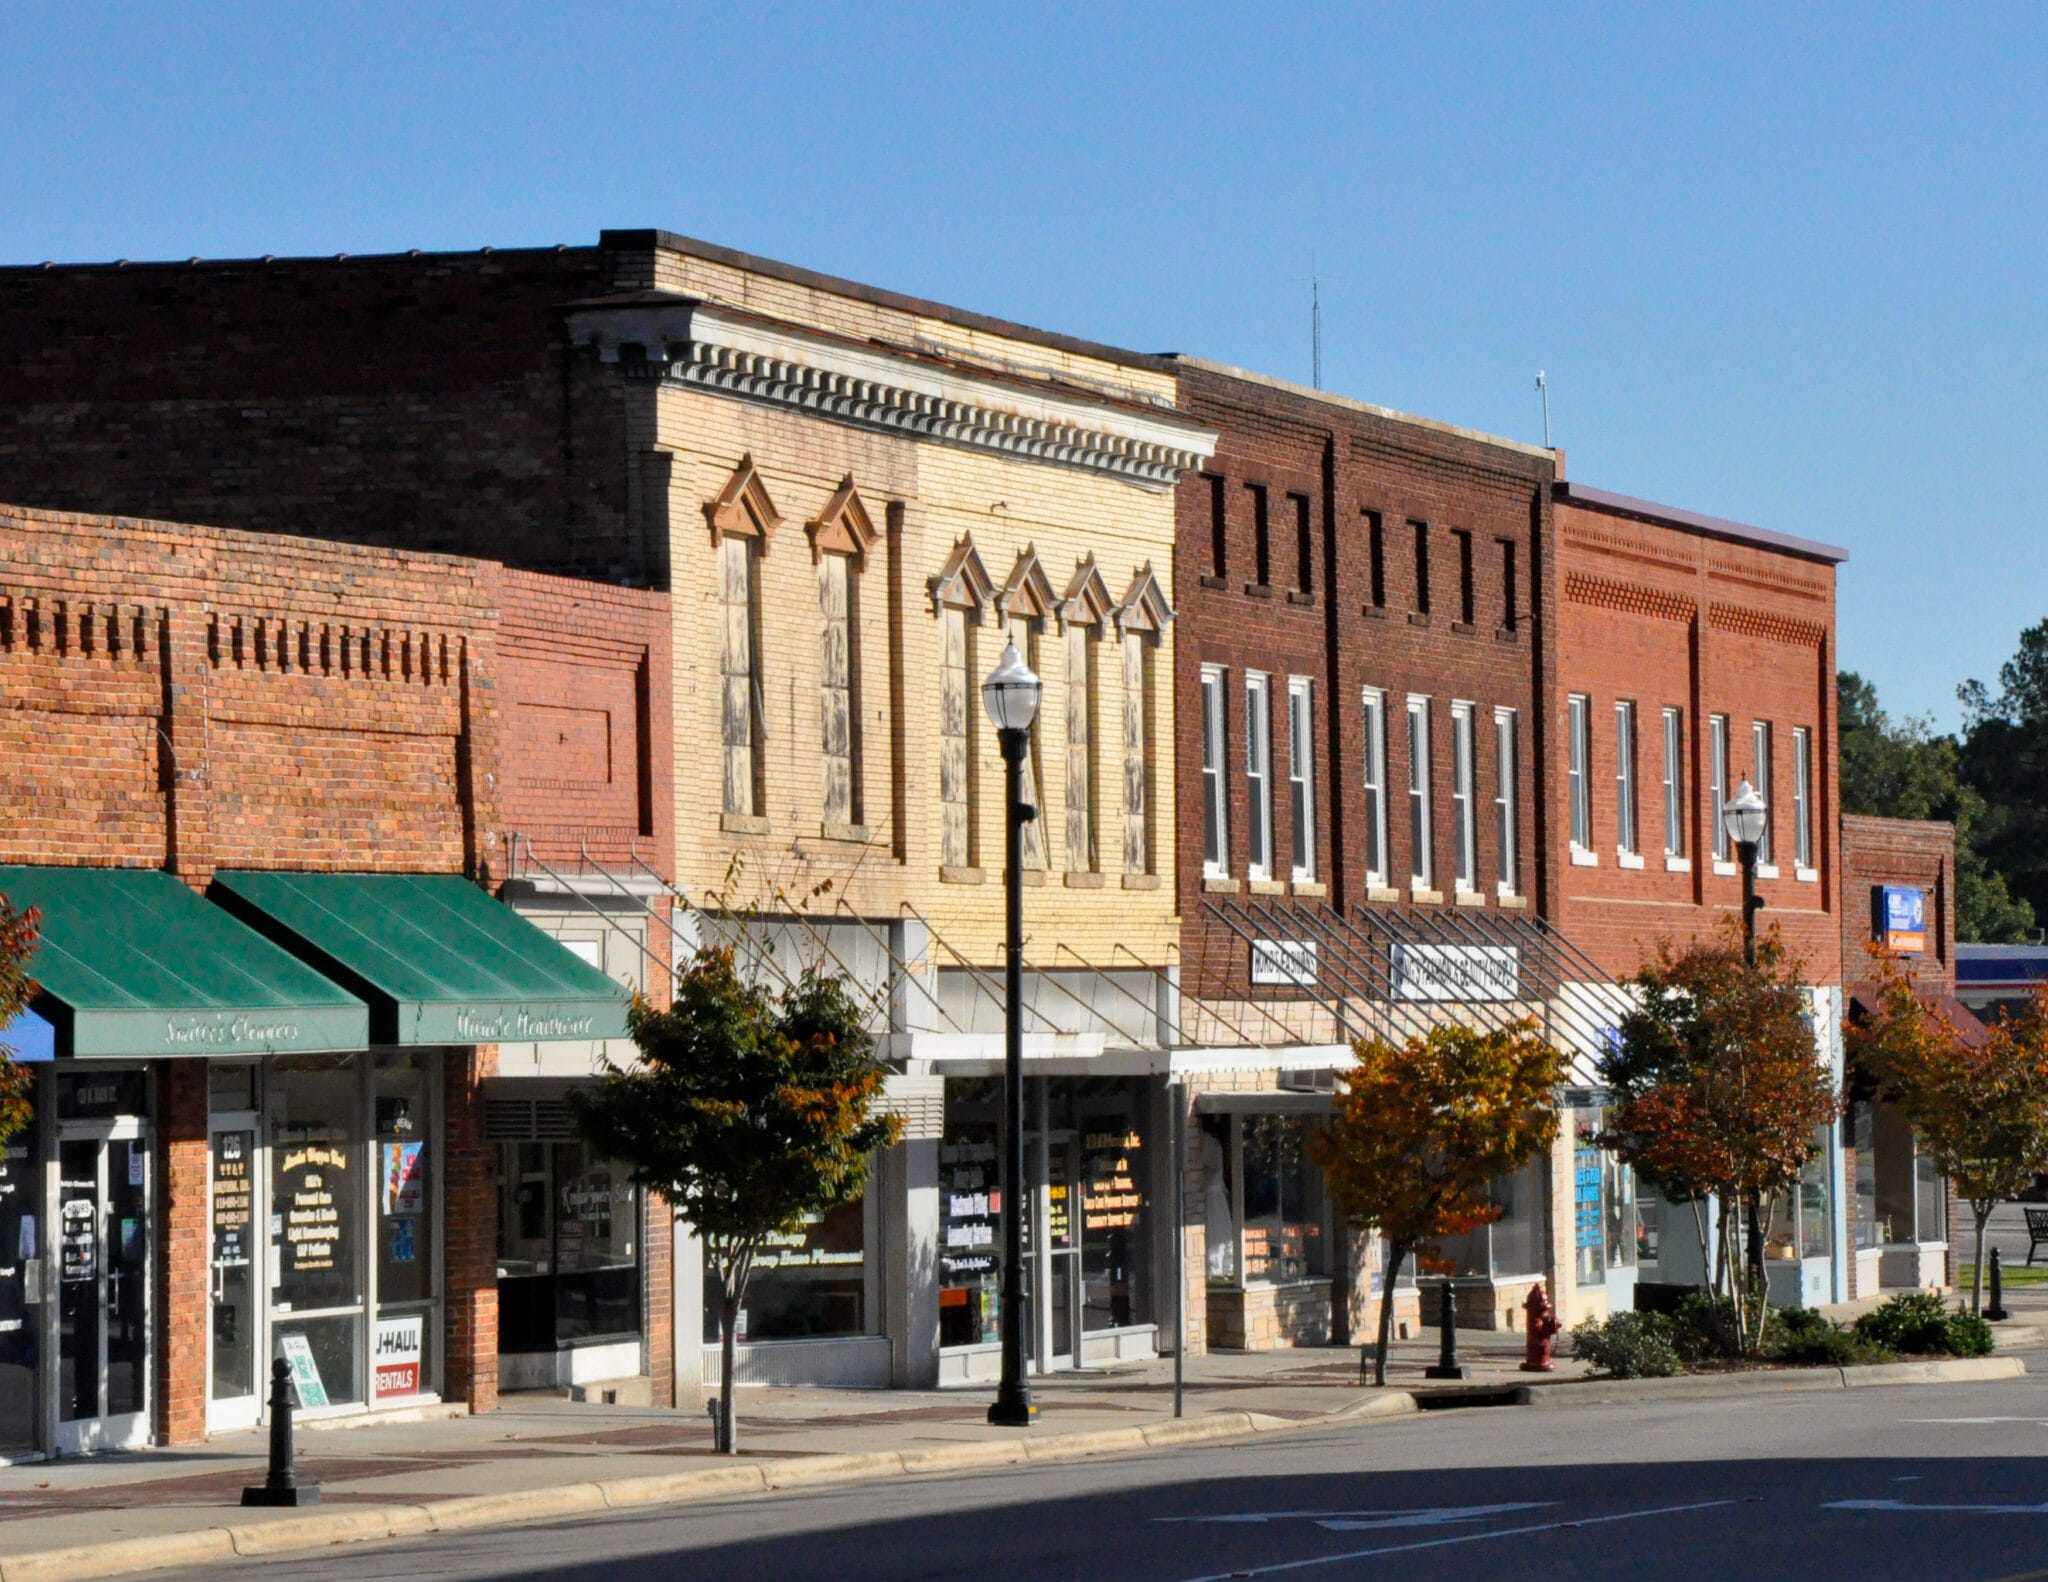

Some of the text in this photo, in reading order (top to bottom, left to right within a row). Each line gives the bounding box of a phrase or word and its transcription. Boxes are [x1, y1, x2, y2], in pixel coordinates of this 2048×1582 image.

[1460, 959, 1488, 987] BEAUTY
[231, 1015, 299, 1042] Cleaners
[222, 1135, 241, 1159] 126
[66, 1203, 90, 1214] HOURS
[779, 1250, 811, 1266] Home
[811, 1248, 864, 1264] Placement
[375, 1369, 413, 1393] RENTALS
